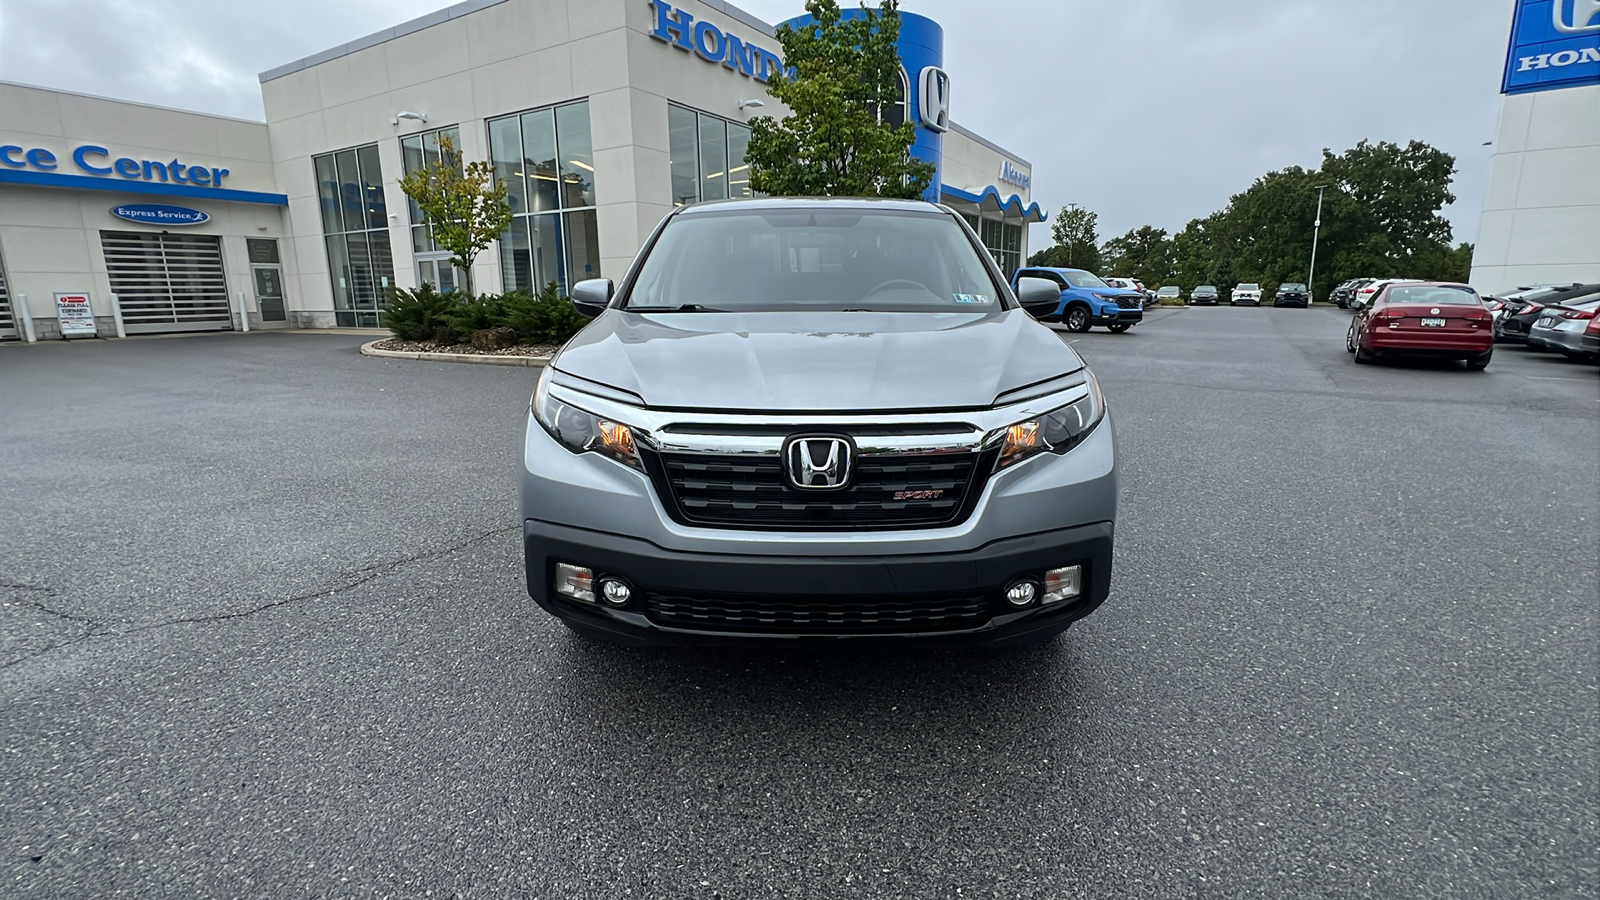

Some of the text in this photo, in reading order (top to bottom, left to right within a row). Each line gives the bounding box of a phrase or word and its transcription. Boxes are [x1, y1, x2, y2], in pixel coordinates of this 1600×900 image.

[71, 145, 231, 188] Center
[118, 207, 192, 219] Express Service
[893, 490, 943, 500] SPORT
